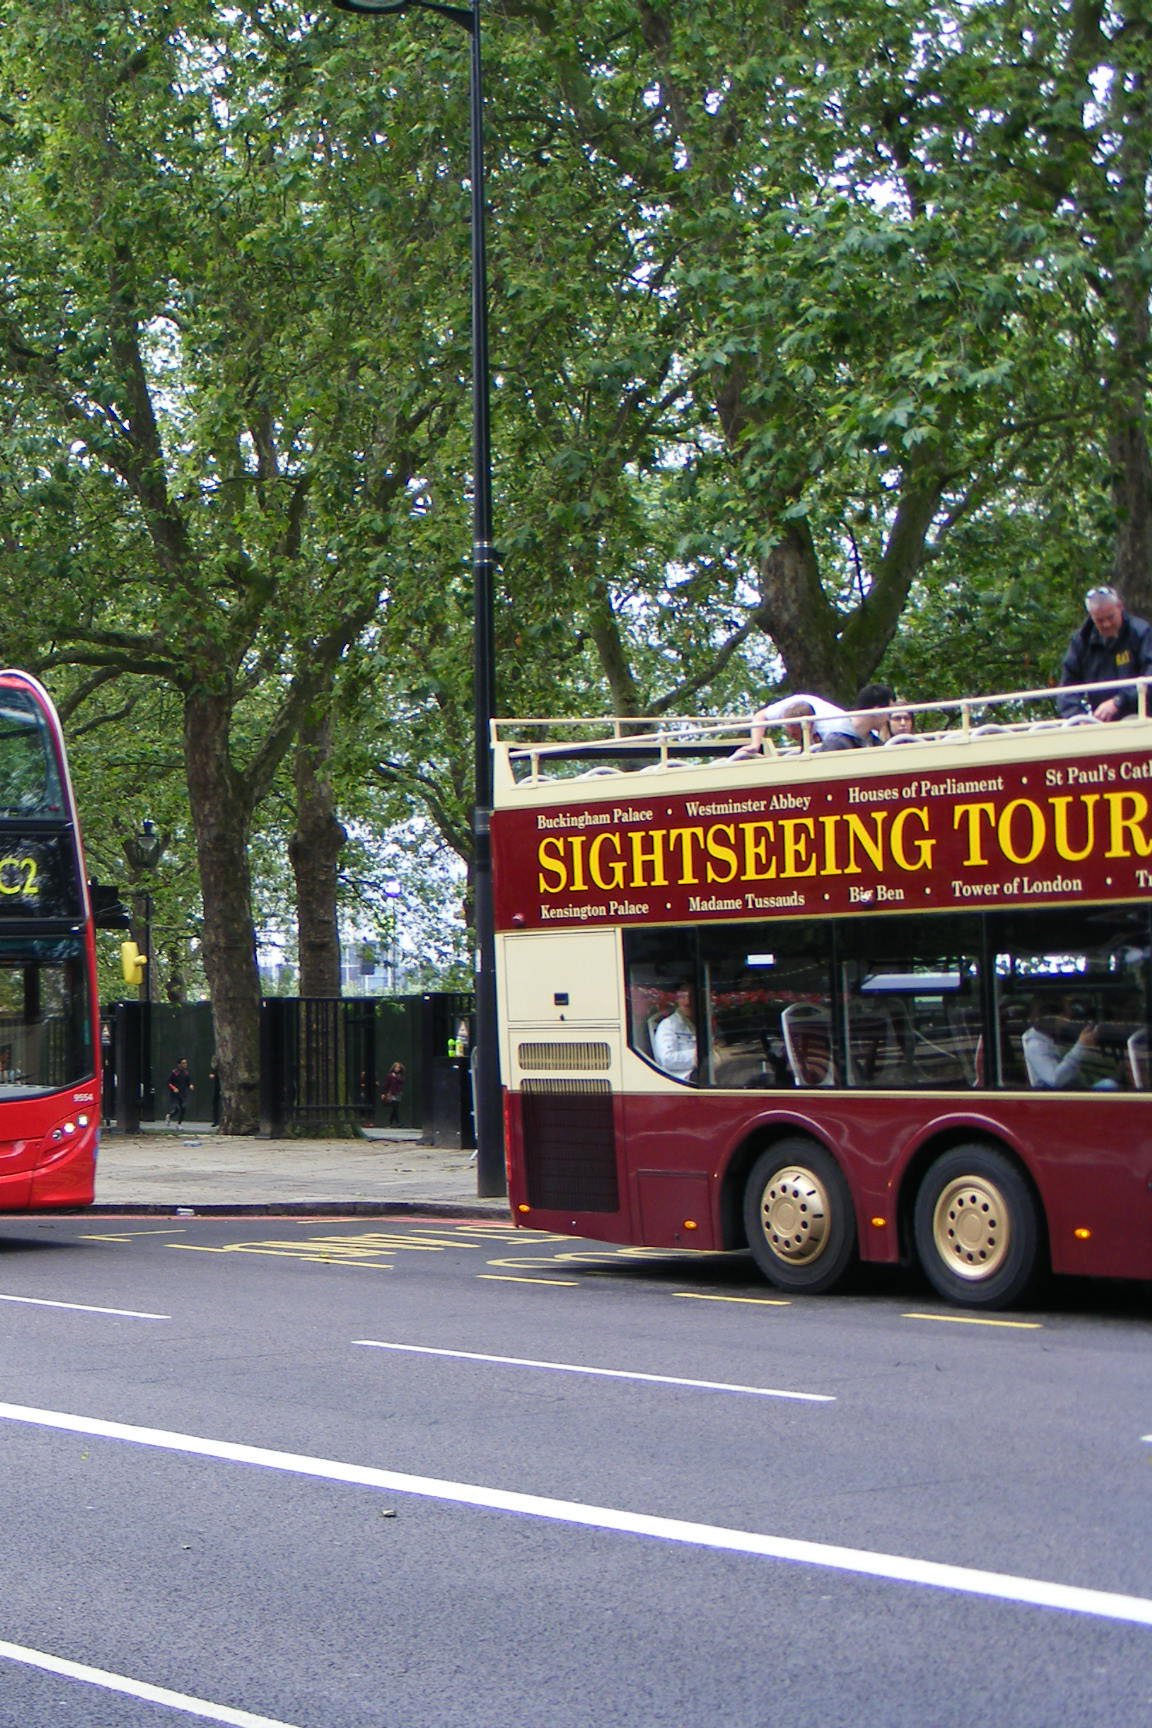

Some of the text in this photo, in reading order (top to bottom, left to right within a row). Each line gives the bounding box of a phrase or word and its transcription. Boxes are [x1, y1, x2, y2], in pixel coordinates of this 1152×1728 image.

[1045, 769, 1063, 786] St
[1067, 764, 1116, 785] Paul's
[848, 776, 1004, 804] Houses of Parliament
[686, 794, 811, 817] Westminster Abbey
[537, 808, 653, 830] Buckingham Palace
[538, 791, 1152, 894] SIGHTSEEING TOUR
[849, 885, 904, 903] Big Ben
[952, 875, 1083, 897] Tower of London
[541, 901, 649, 921] Kensington Palace
[689, 891, 805, 912] Madame Tussauds
